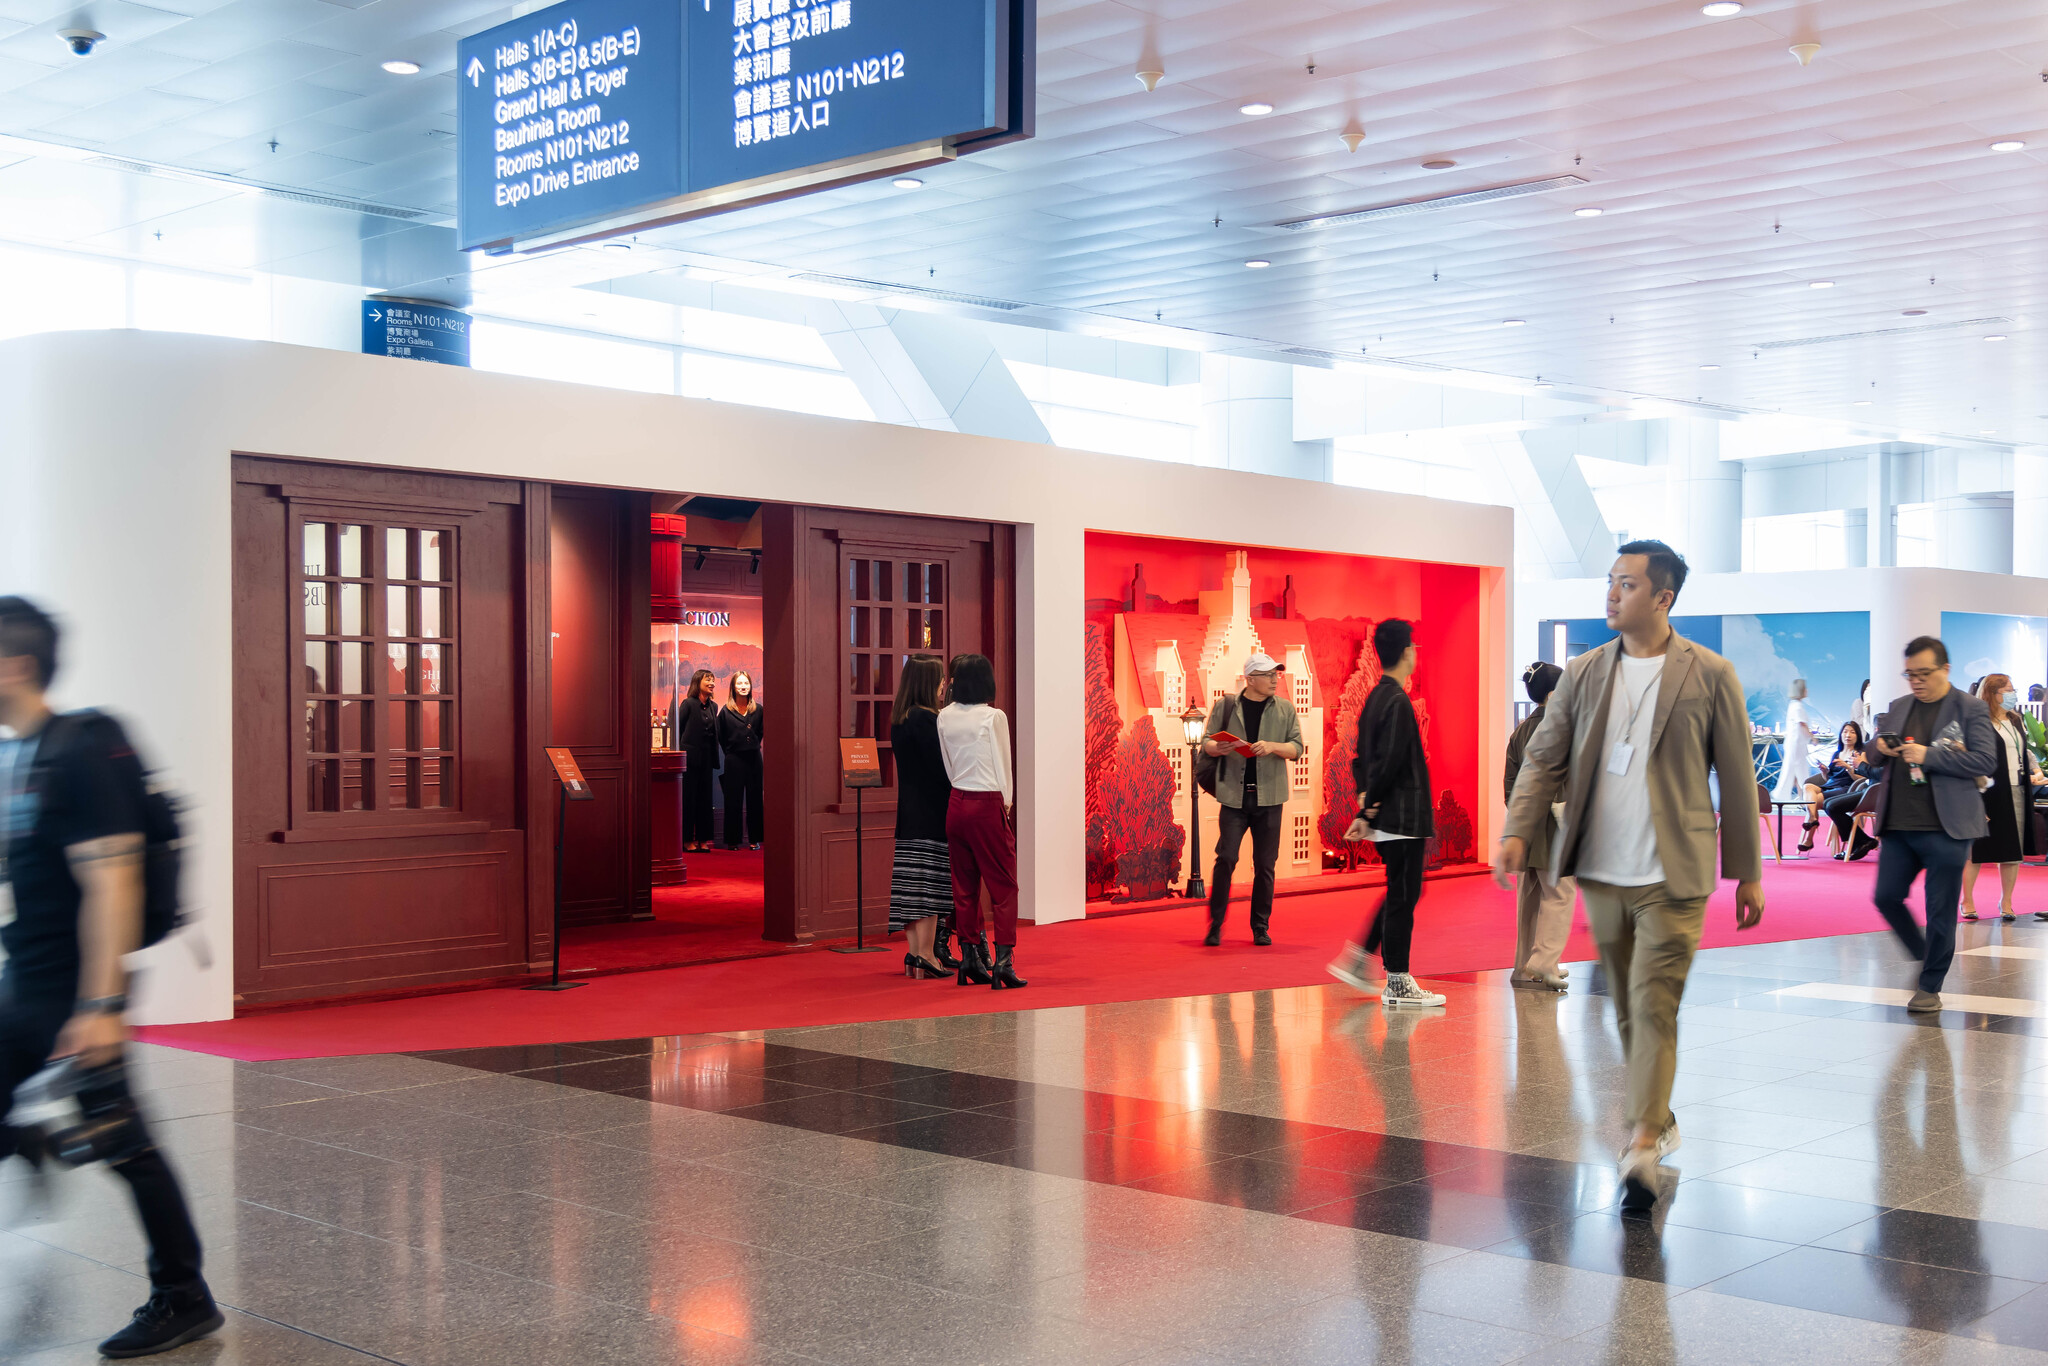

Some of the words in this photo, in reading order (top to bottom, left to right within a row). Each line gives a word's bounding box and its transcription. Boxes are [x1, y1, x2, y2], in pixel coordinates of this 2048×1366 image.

[496, 41, 529, 70] Halls
[533, 19, 578, 57] 1(A-C)
[733, 0, 852, 57] 大會堂及前廳
[495, 70, 529, 97] Halls
[531, 48, 577, 84] 3(B-E)
[578, 50, 590, 70] &
[591, 26, 640, 66] 5(B-E)
[733, 46, 791, 86] 紫荊廳
[733, 78, 791, 118] 會議室
[796, 51, 905, 102] N101-N212
[495, 95, 537, 124] Grand
[540, 82, 567, 110] Hall
[570, 80, 582, 100] &
[585, 66, 629, 98] Foyer
[496, 117, 554, 152] Bauhinia
[557, 104, 600, 132] Room
[733, 100, 830, 148] 博覽道入口
[496, 150, 543, 179] Rooms
[546, 122, 630, 165] N101-N212
[496, 183, 530, 208] Expo
[533, 168, 569, 197] Drive
[573, 151, 640, 185] Entrance
[387, 317, 413, 326] Rooms
[414, 313, 465, 332] N101-N212
[387, 336, 406, 345] Expo
[408, 337, 434, 346] Galleria
[685, 611, 730, 627] CTION
